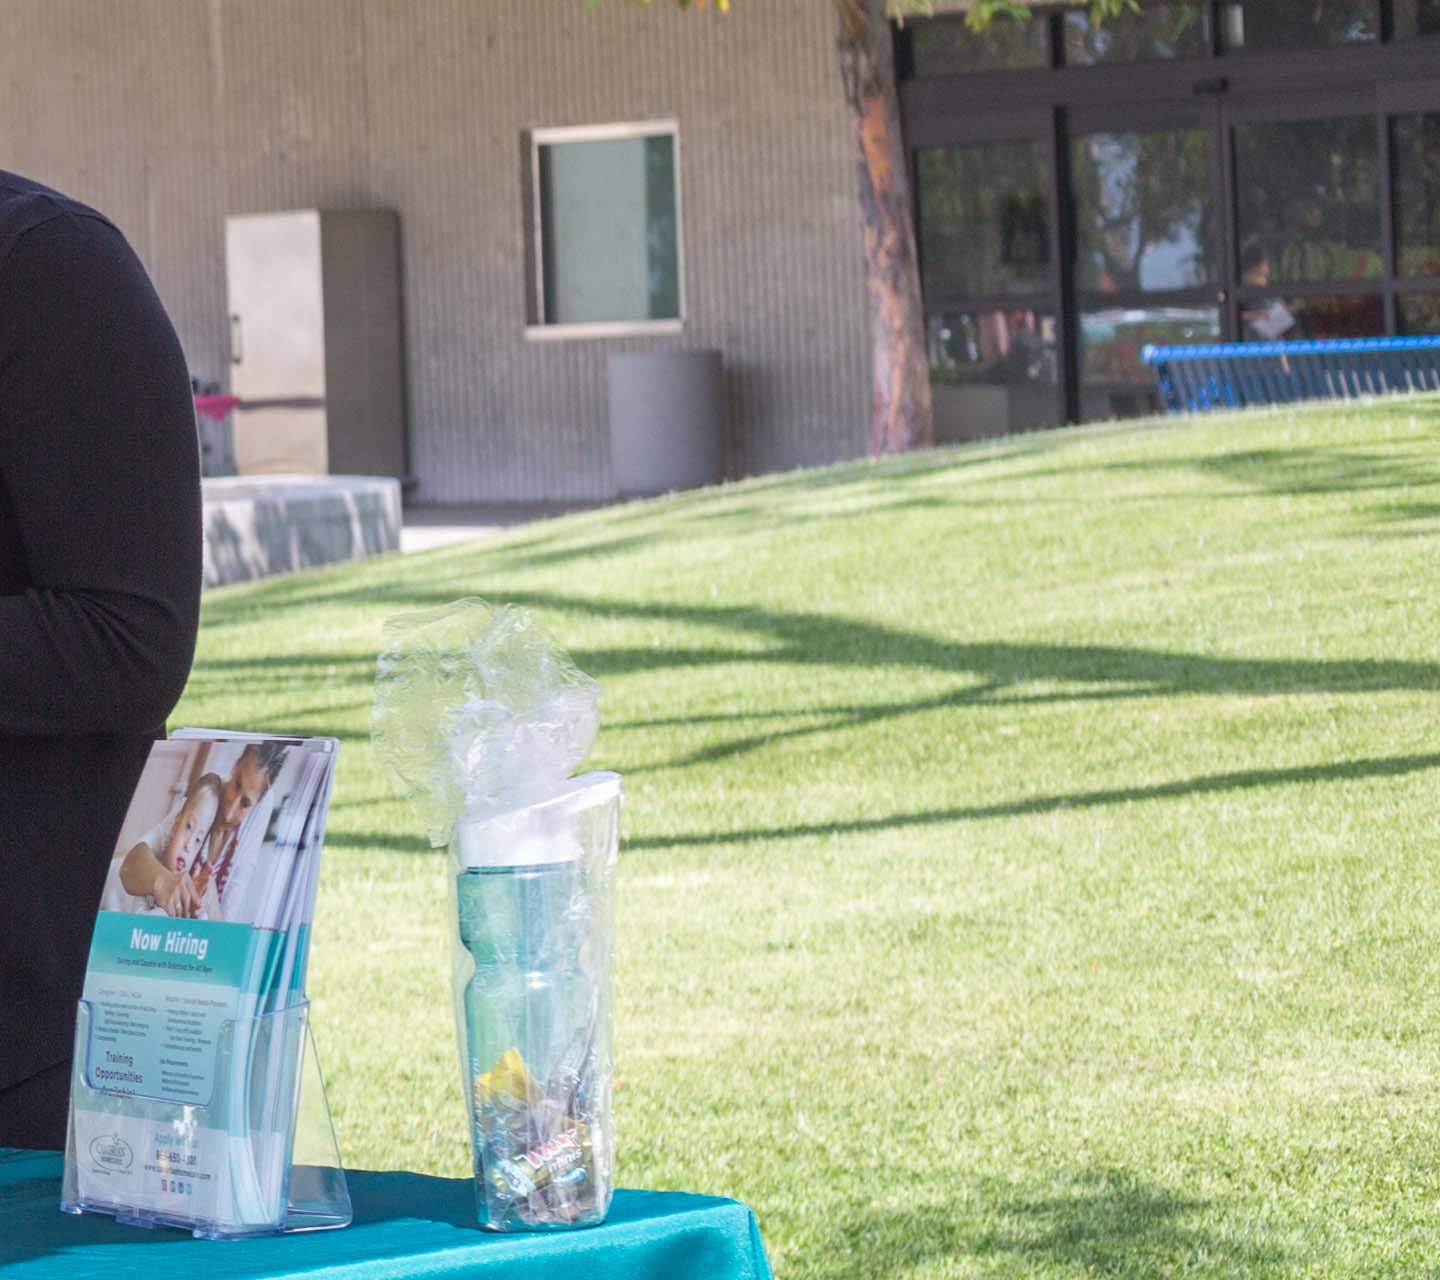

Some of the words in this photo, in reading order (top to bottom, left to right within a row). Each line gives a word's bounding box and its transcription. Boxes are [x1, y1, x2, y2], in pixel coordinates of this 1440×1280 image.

[130, 928, 162, 951] Now
[165, 931, 209, 961] Hiring
[105, 1050, 134, 1067] Training
[95, 1066, 143, 1084] Opportunities
